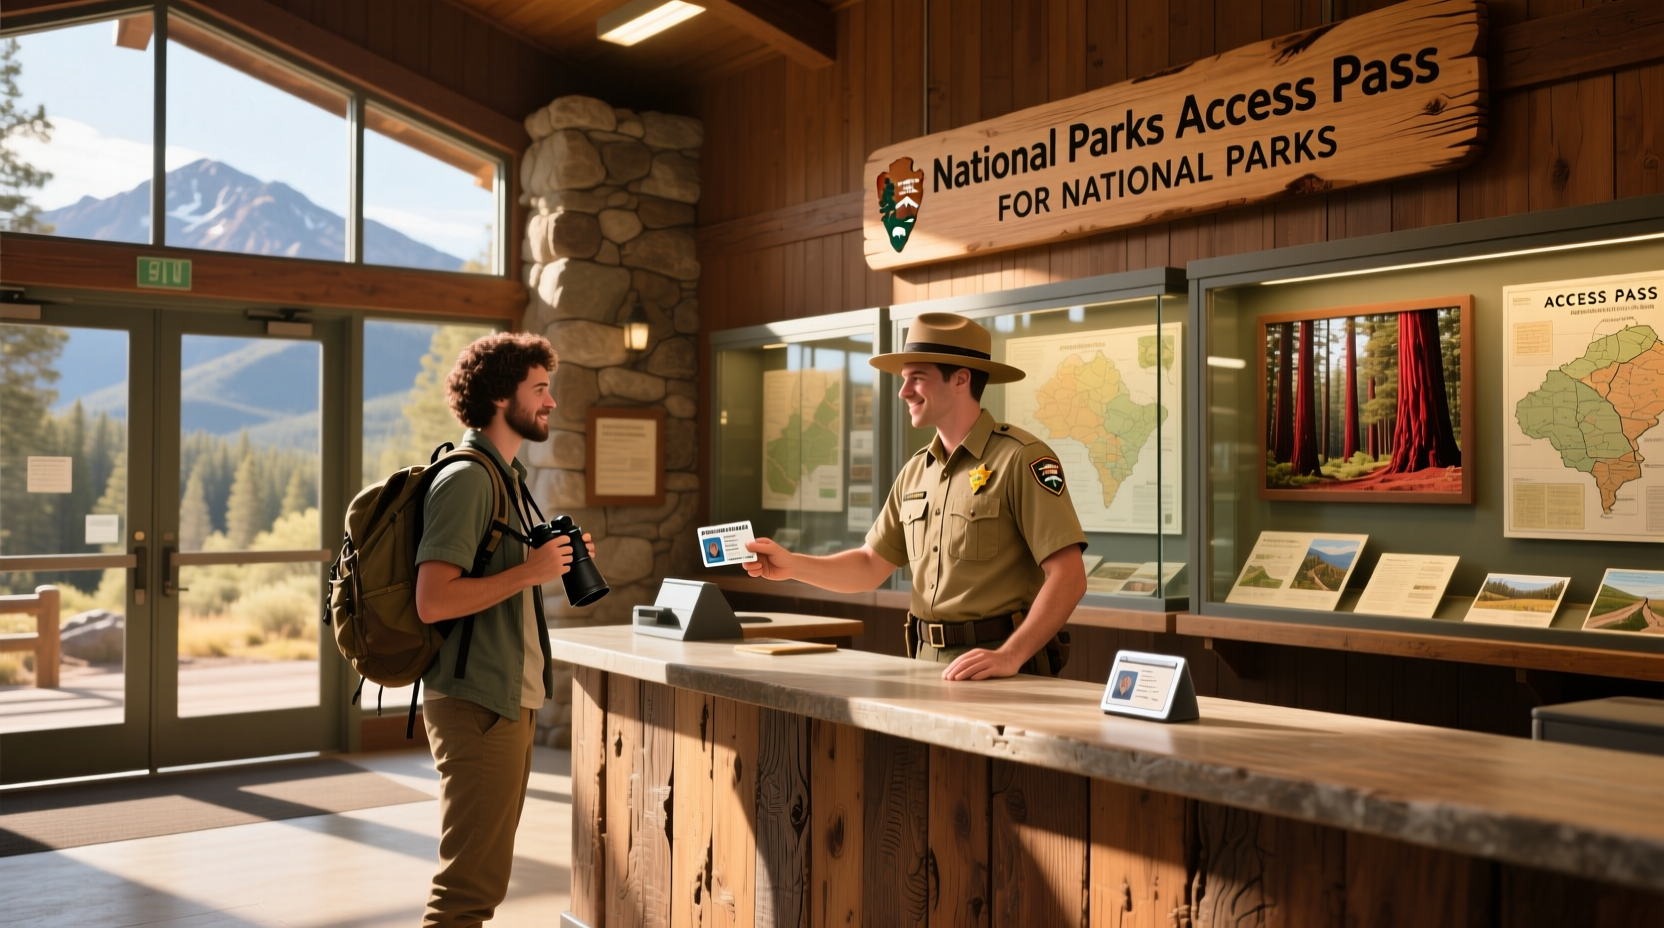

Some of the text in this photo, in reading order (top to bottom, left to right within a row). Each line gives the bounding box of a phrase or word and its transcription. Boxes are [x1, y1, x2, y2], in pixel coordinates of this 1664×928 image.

[932, 46, 1440, 193] National Parks Access Pass
[998, 125, 1338, 222] FOR NATIONAL PARKS
[1544, 290, 1607, 308] ACCESS
[1615, 286, 1658, 303] PASS
